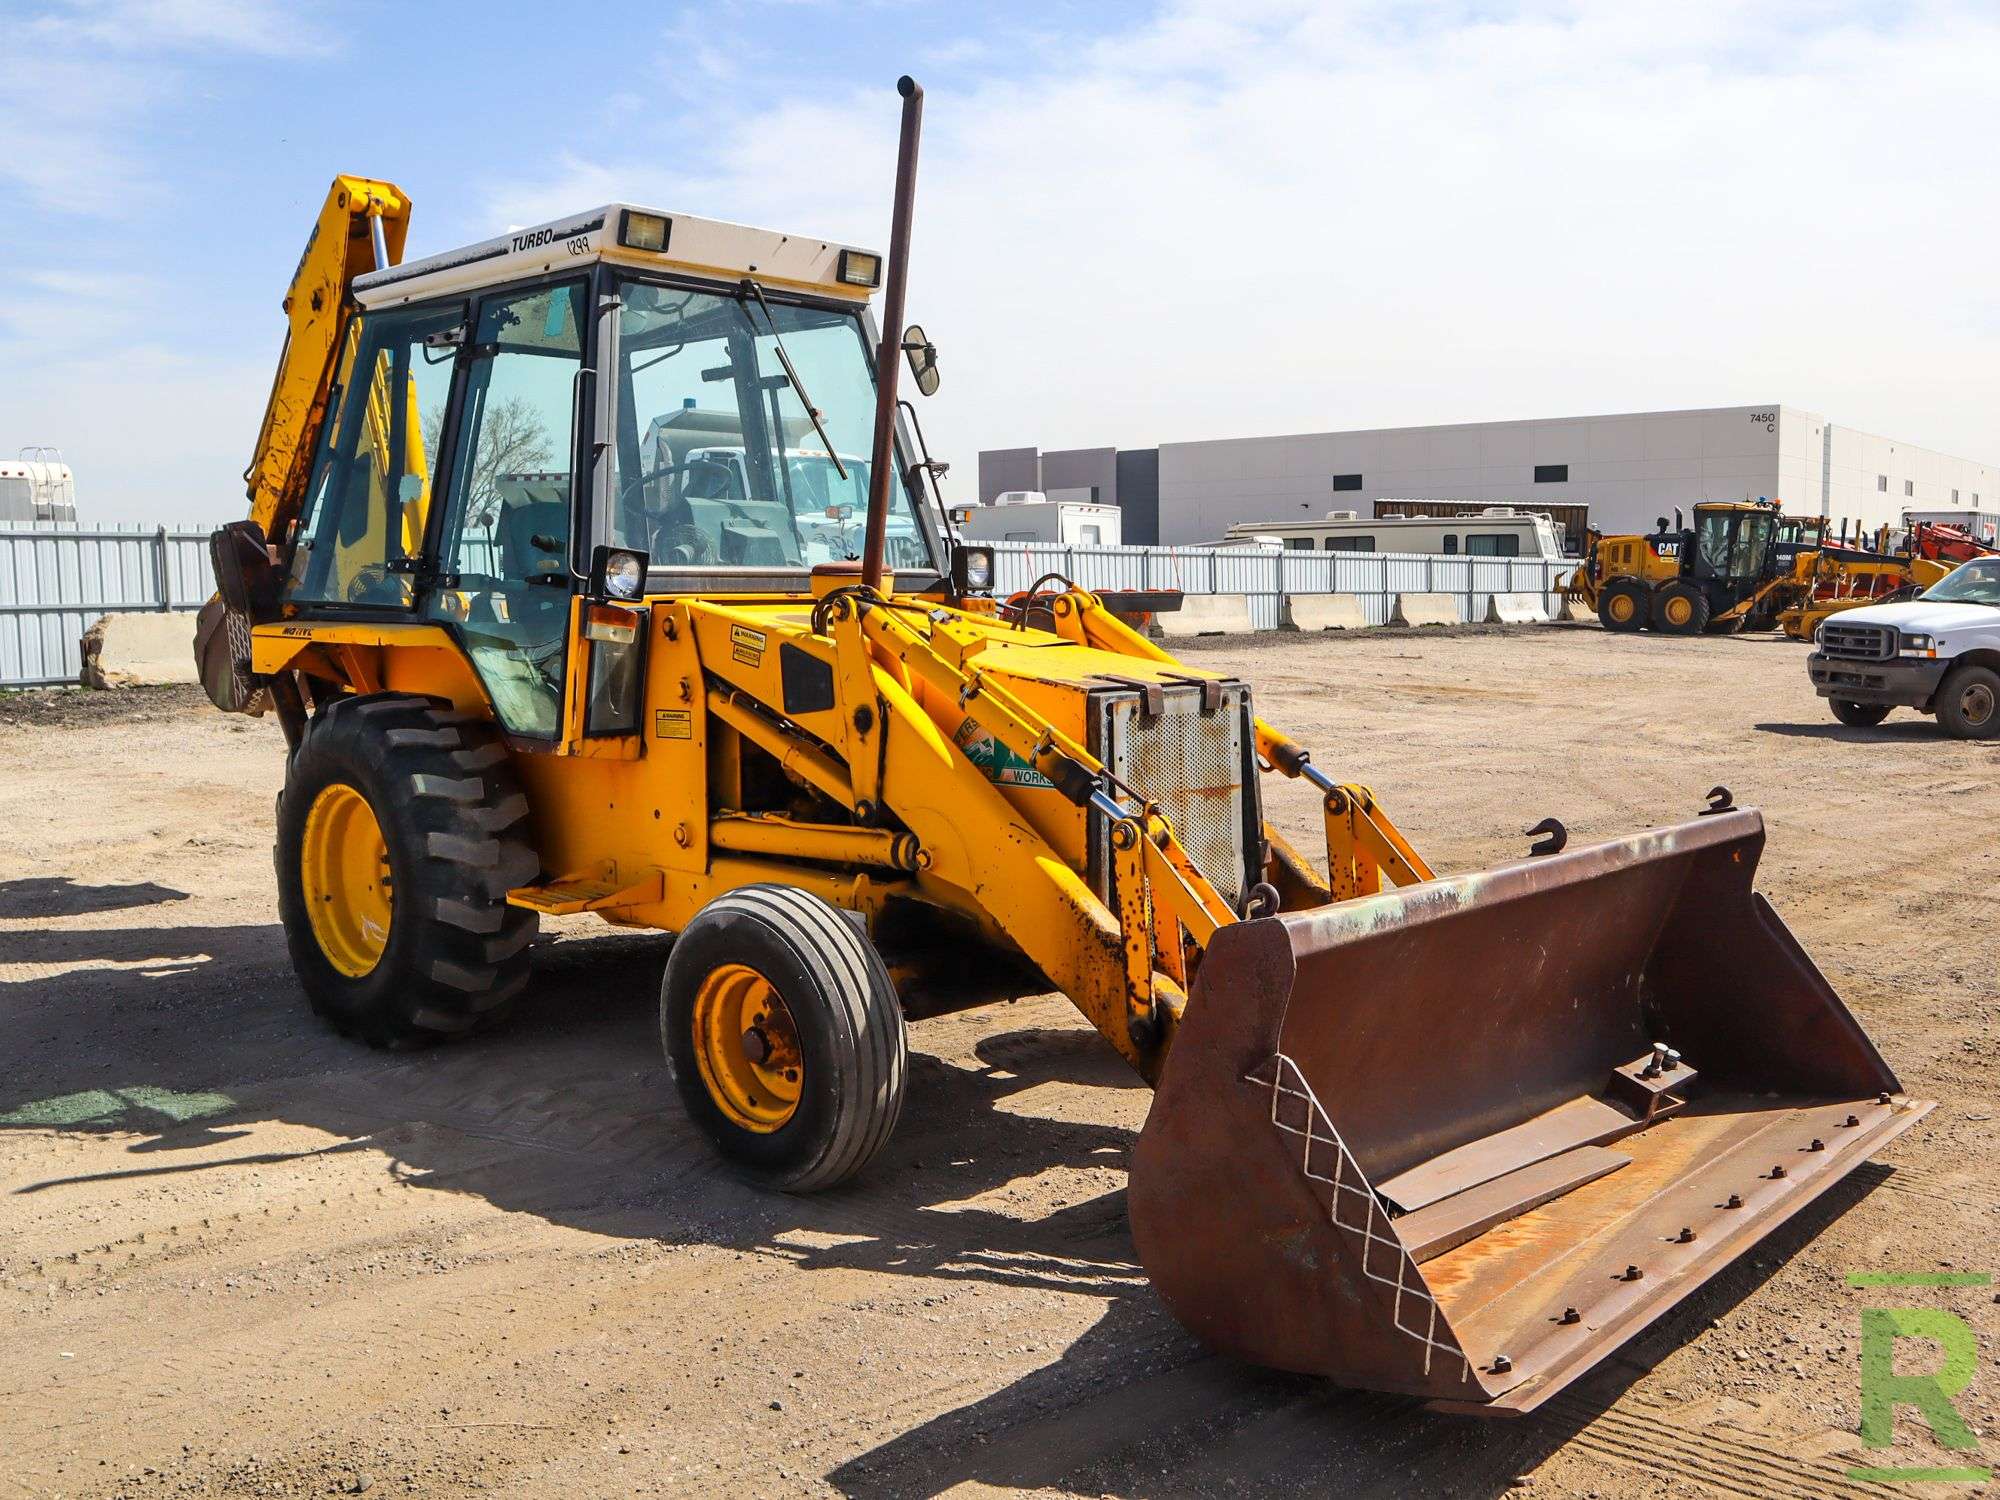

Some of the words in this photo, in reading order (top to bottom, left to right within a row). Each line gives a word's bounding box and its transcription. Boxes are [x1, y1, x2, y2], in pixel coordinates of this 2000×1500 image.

[512, 228, 553, 252] TURBO
[567, 236, 591, 256] 1299
[1750, 413, 1775, 423] 7450
[1766, 423, 1775, 433] C
[1658, 542, 1679, 556] CAT
